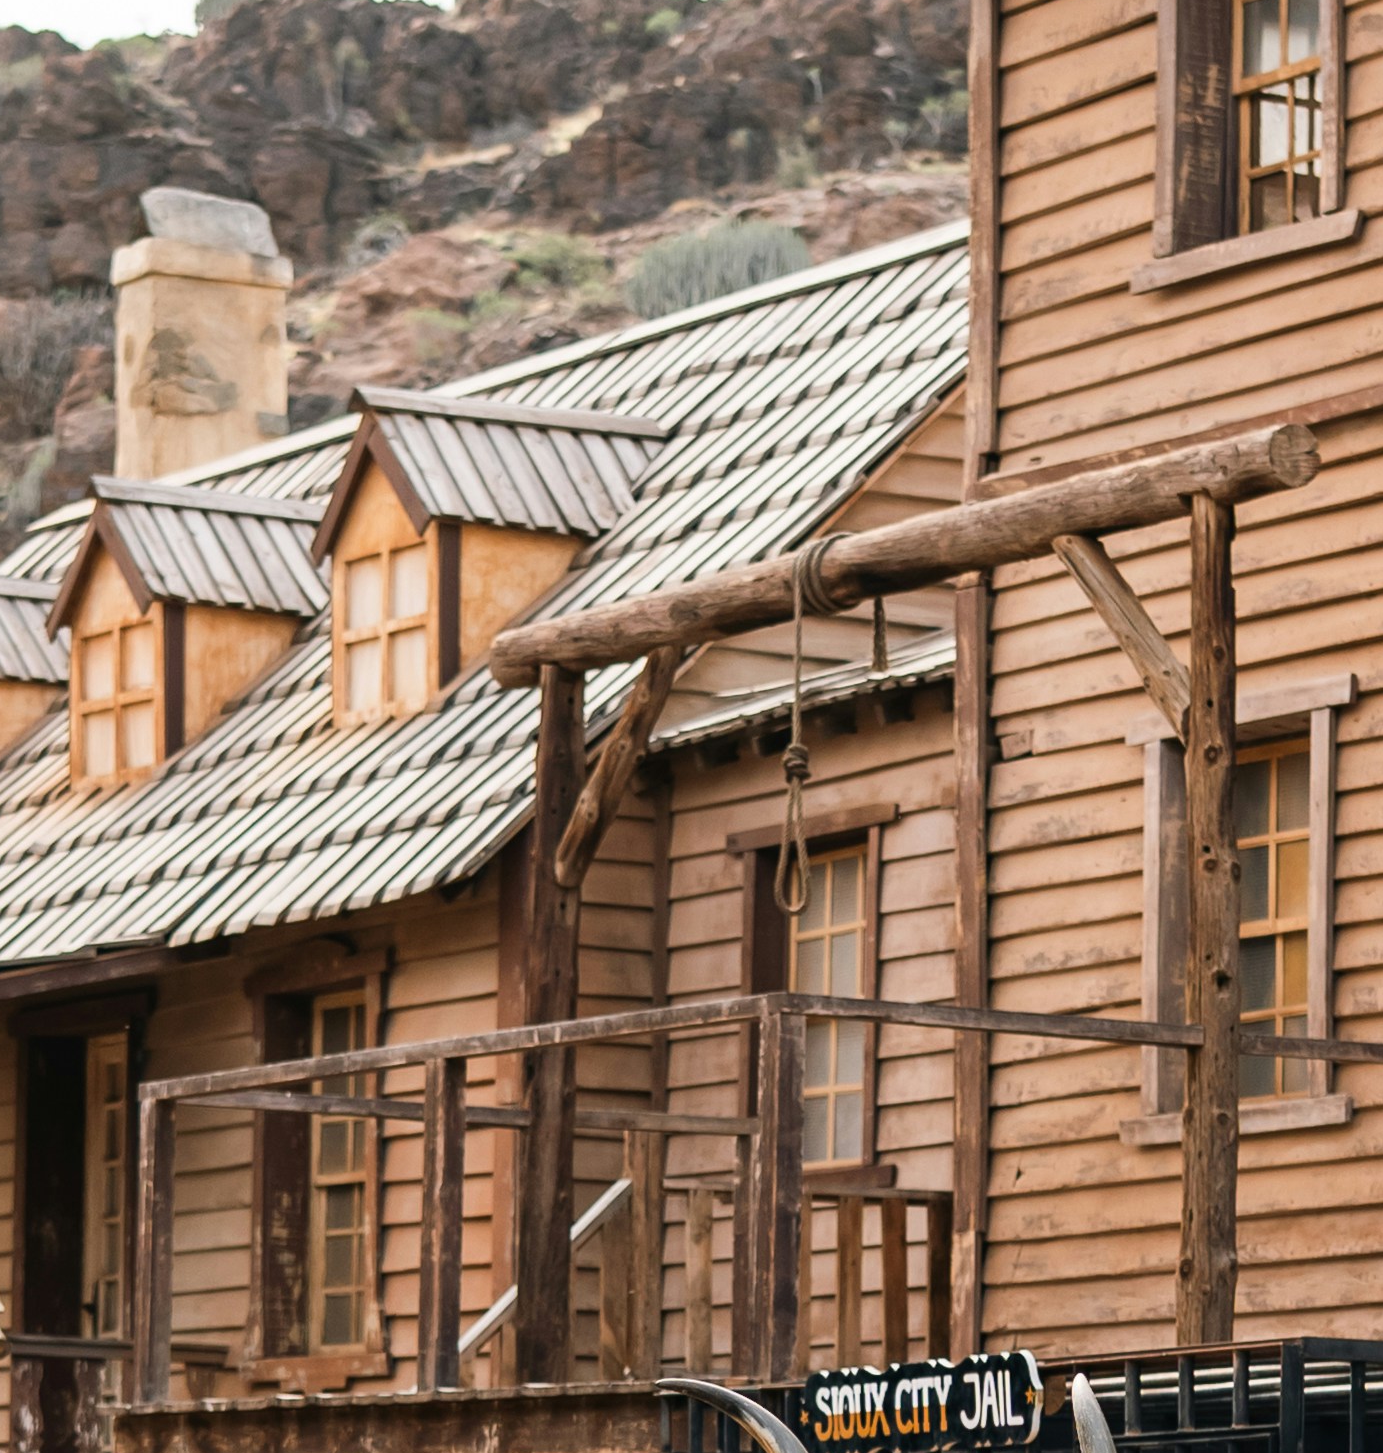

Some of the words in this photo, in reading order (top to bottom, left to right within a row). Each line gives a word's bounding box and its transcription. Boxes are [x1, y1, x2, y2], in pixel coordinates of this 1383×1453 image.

[814, 1381, 891, 1441] SIOUX
[895, 1374, 953, 1435] CITY
[960, 1369, 1024, 1430] JAIL
